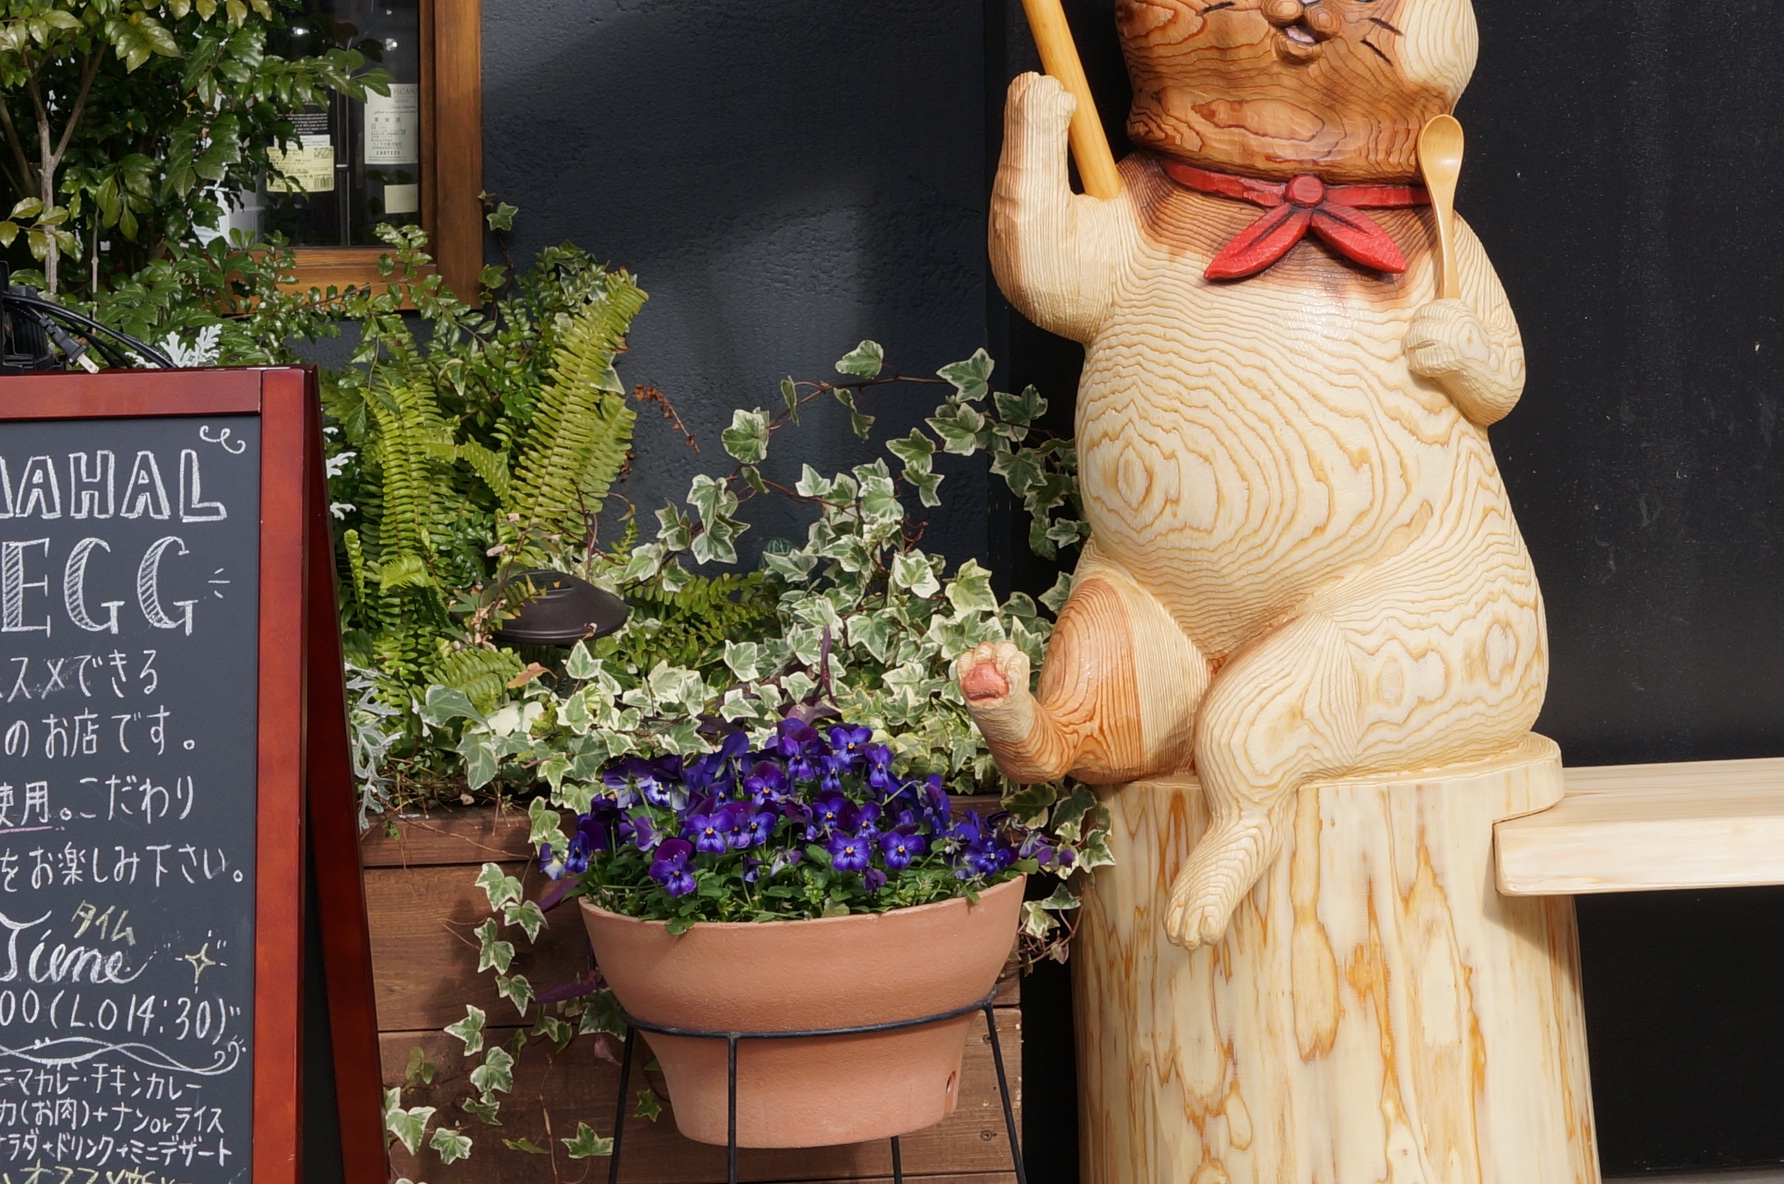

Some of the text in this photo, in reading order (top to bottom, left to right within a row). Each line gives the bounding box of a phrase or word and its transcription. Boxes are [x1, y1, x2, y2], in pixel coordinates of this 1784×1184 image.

[1, 535, 199, 638] EGG
[0, 648, 158, 703] スメできる
[4, 704, 196, 760] のお店です。
[0, 841, 244, 893] をお楽しみ下さい。
[0, 1127, 233, 1167] ラダ+ドリンク+ミニデザート
